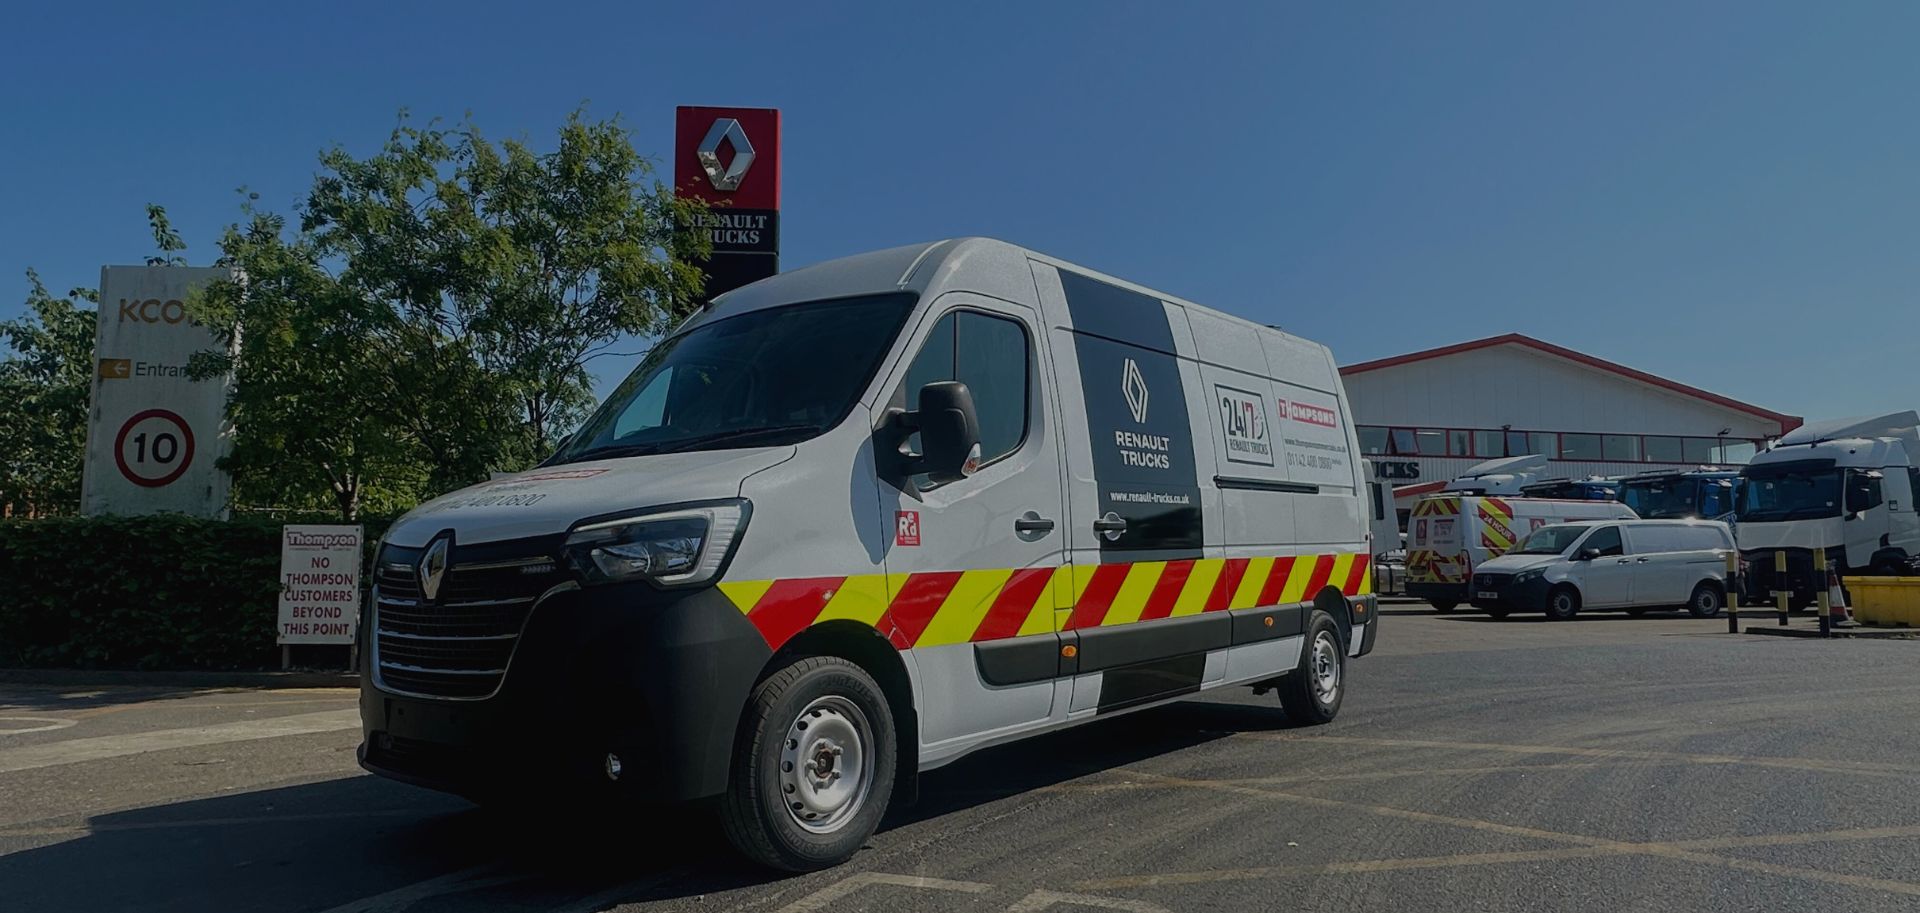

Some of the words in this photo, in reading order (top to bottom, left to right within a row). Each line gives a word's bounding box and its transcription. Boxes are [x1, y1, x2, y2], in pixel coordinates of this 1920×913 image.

[119, 299, 195, 324] KCO
[1280, 399, 1336, 428] THOMPSONS
[134, 432, 178, 464] 10
[1115, 431, 1170, 451] RENAULT
[1120, 450, 1170, 469] TRUCKS
[1110, 492, 1190, 504] www.renault-trucks.co.uk
[1484, 514, 1493, 525] 24
[1492, 522, 1512, 540] HOUR
[287, 531, 358, 549] Thompson
[311, 556, 331, 569] NO
[286, 573, 353, 586] THOMPSON
[284, 590, 353, 602] CUSTOMERS
[292, 606, 342, 618] BEYOND
[283, 623, 309, 635] THIS
[313, 623, 350, 636] POINT
